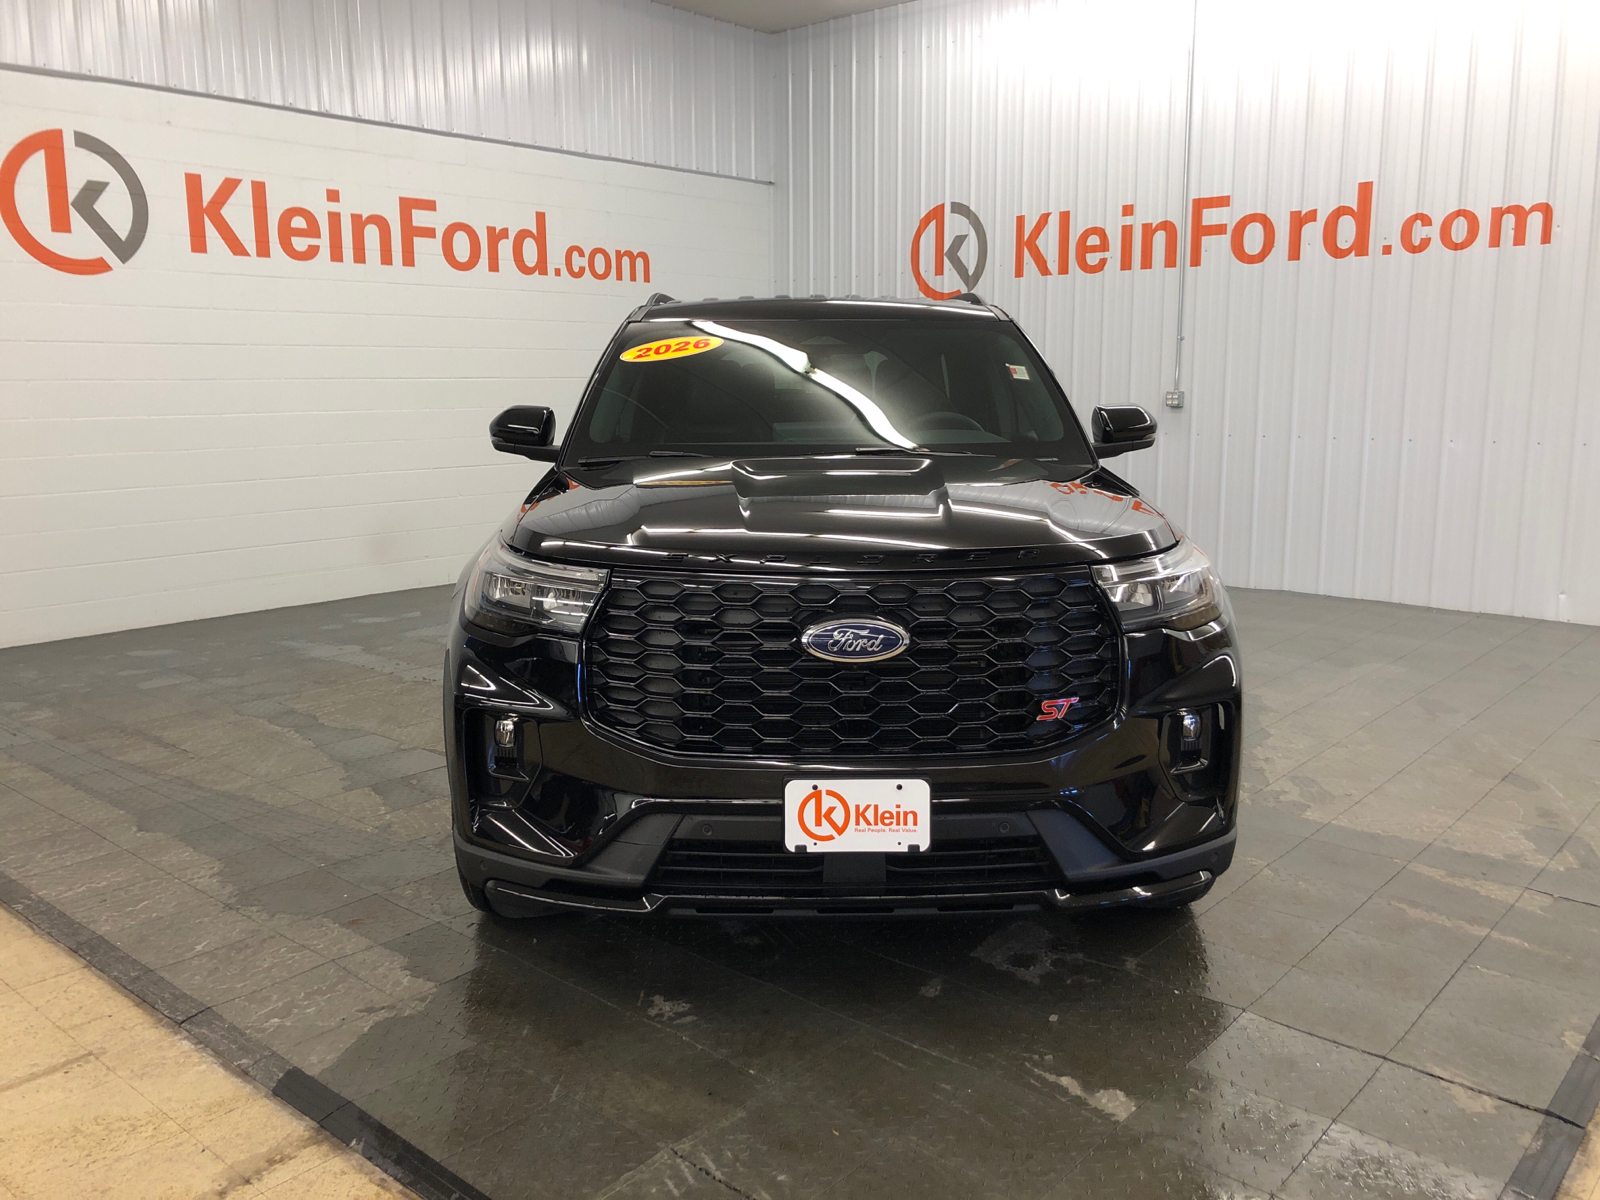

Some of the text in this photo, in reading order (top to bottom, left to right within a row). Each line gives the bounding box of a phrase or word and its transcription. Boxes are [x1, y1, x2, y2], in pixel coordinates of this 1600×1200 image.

[184, 172, 651, 283] KleinFord.com
[1014, 181, 1555, 278] KleinFord.com
[632, 338, 712, 360] 2026
[660, 548, 1040, 566] EXPLORER
[828, 628, 883, 652] Ford
[1036, 697, 1079, 721] ST
[854, 804, 918, 827] Klein
